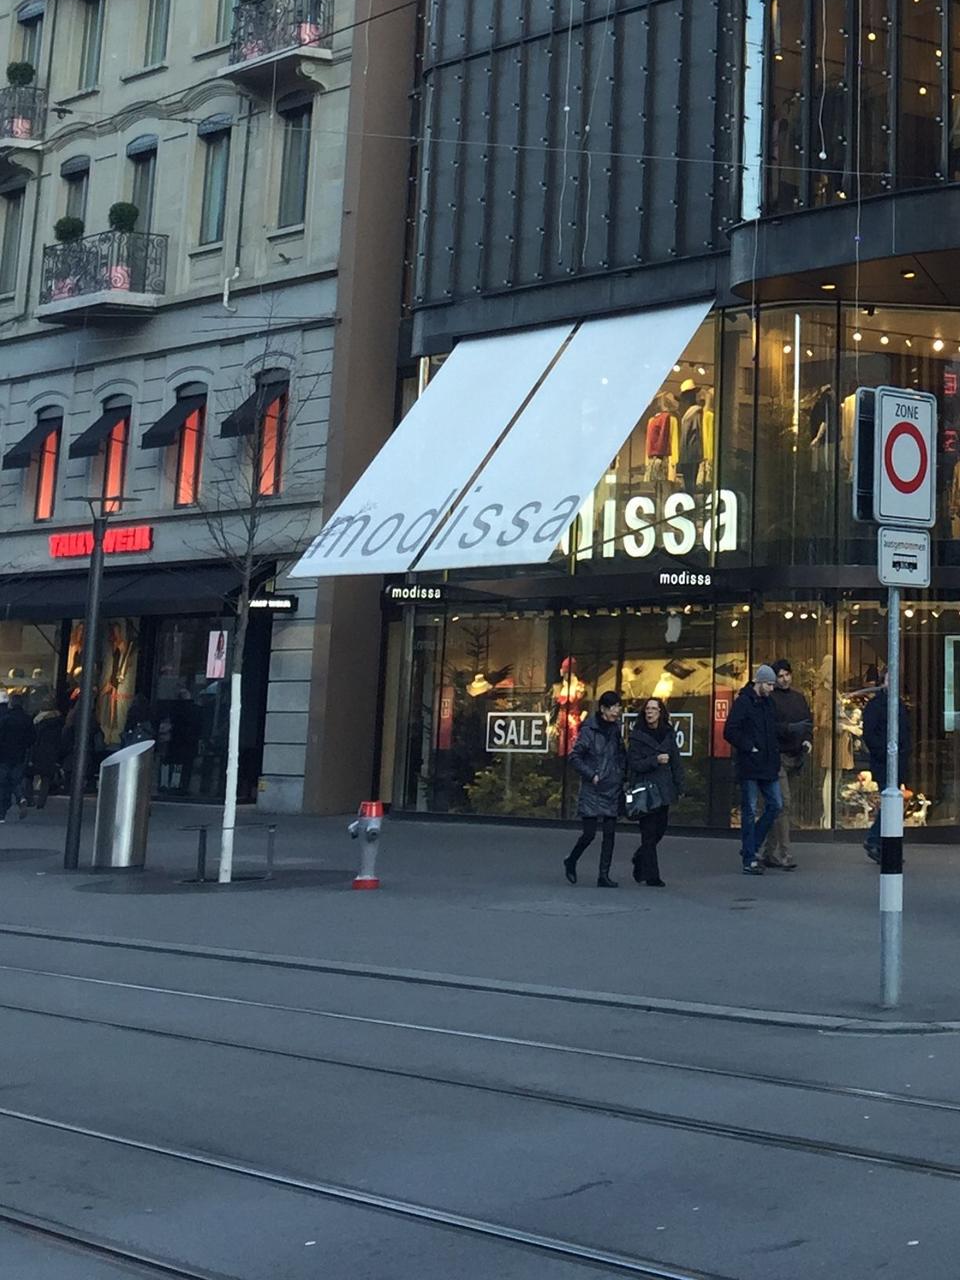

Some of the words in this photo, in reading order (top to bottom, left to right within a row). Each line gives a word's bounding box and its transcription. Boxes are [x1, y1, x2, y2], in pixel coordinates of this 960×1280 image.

[895, 402, 919, 420] ZONE
[302, 485, 581, 559] modissa
[560, 473, 738, 560] dissa
[659, 571, 712, 586] modissa
[391, 585, 441, 599] modissa
[493, 719, 543, 746] SALE
